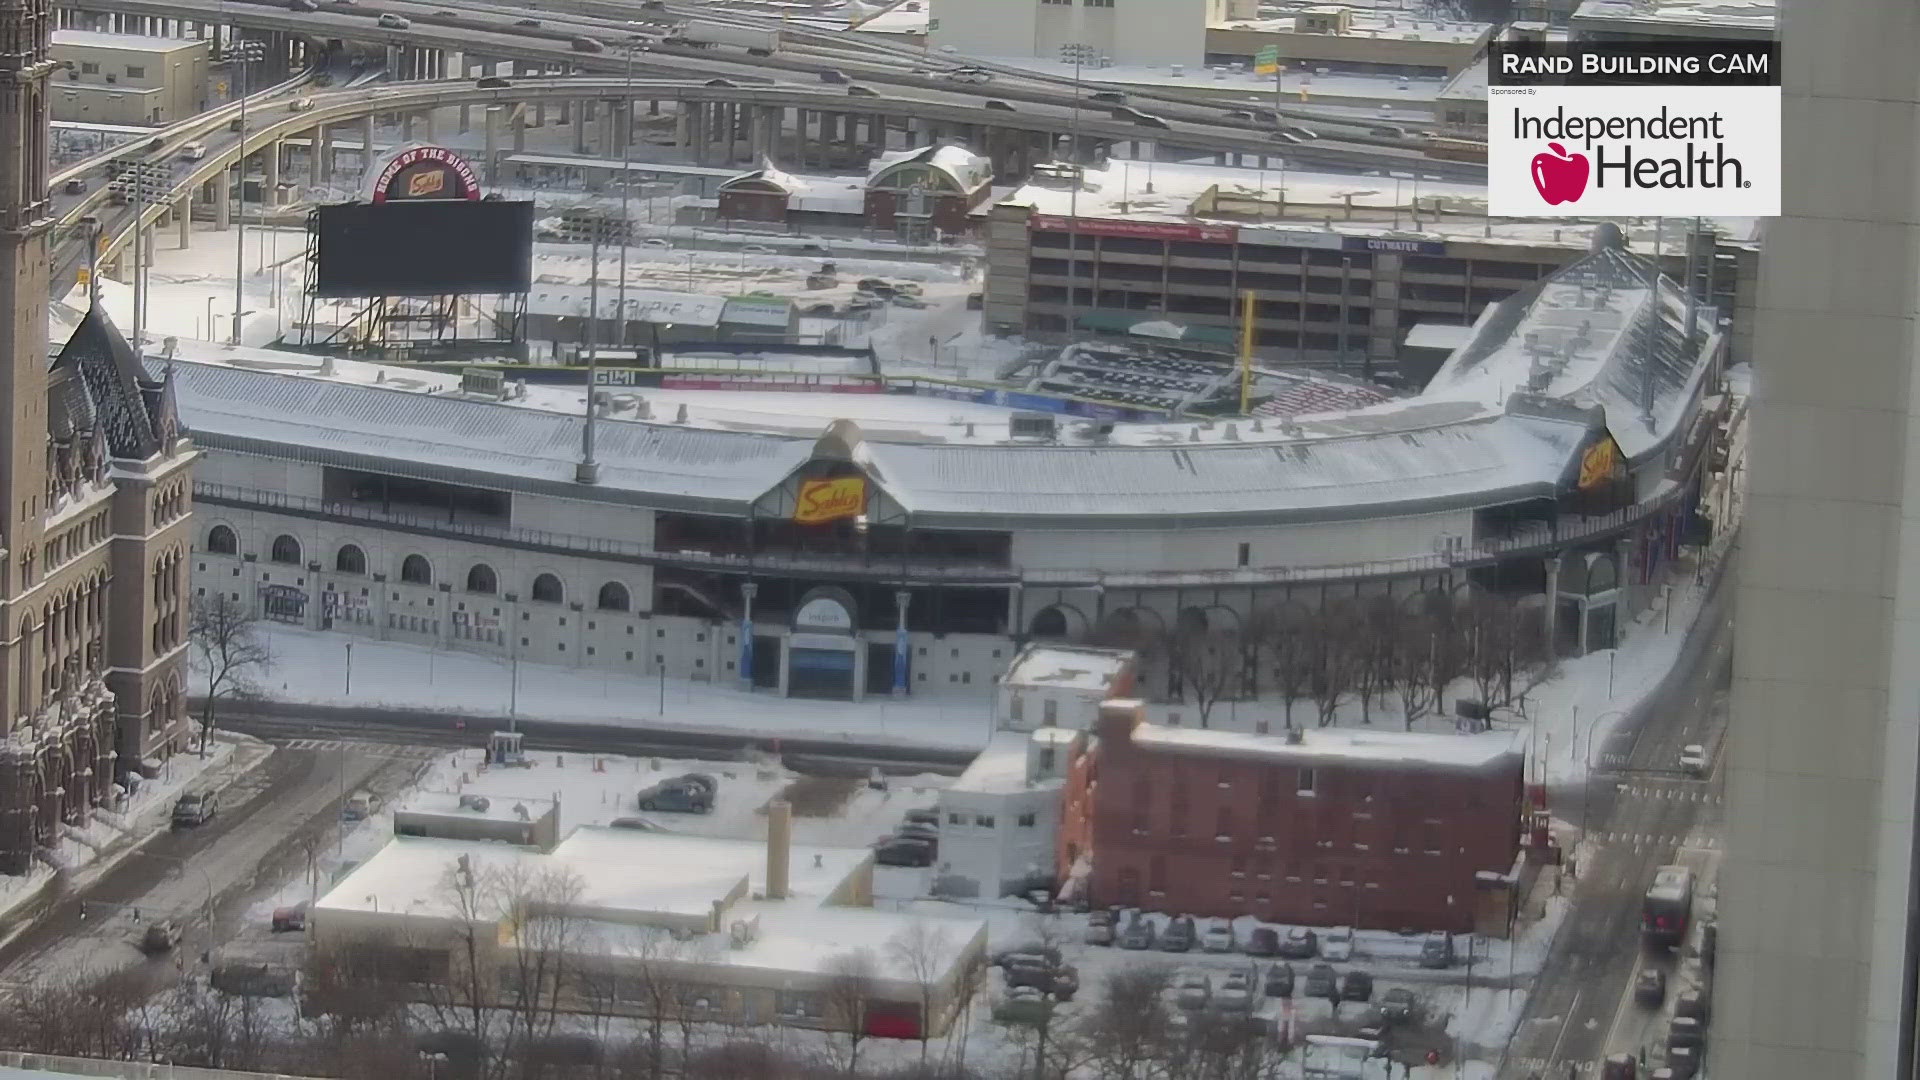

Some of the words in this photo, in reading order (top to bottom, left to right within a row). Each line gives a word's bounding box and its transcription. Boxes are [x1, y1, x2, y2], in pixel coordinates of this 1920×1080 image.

[377, 161, 401, 193] HOME
[402, 151, 417, 164] OF
[421, 148, 445, 161] THE
